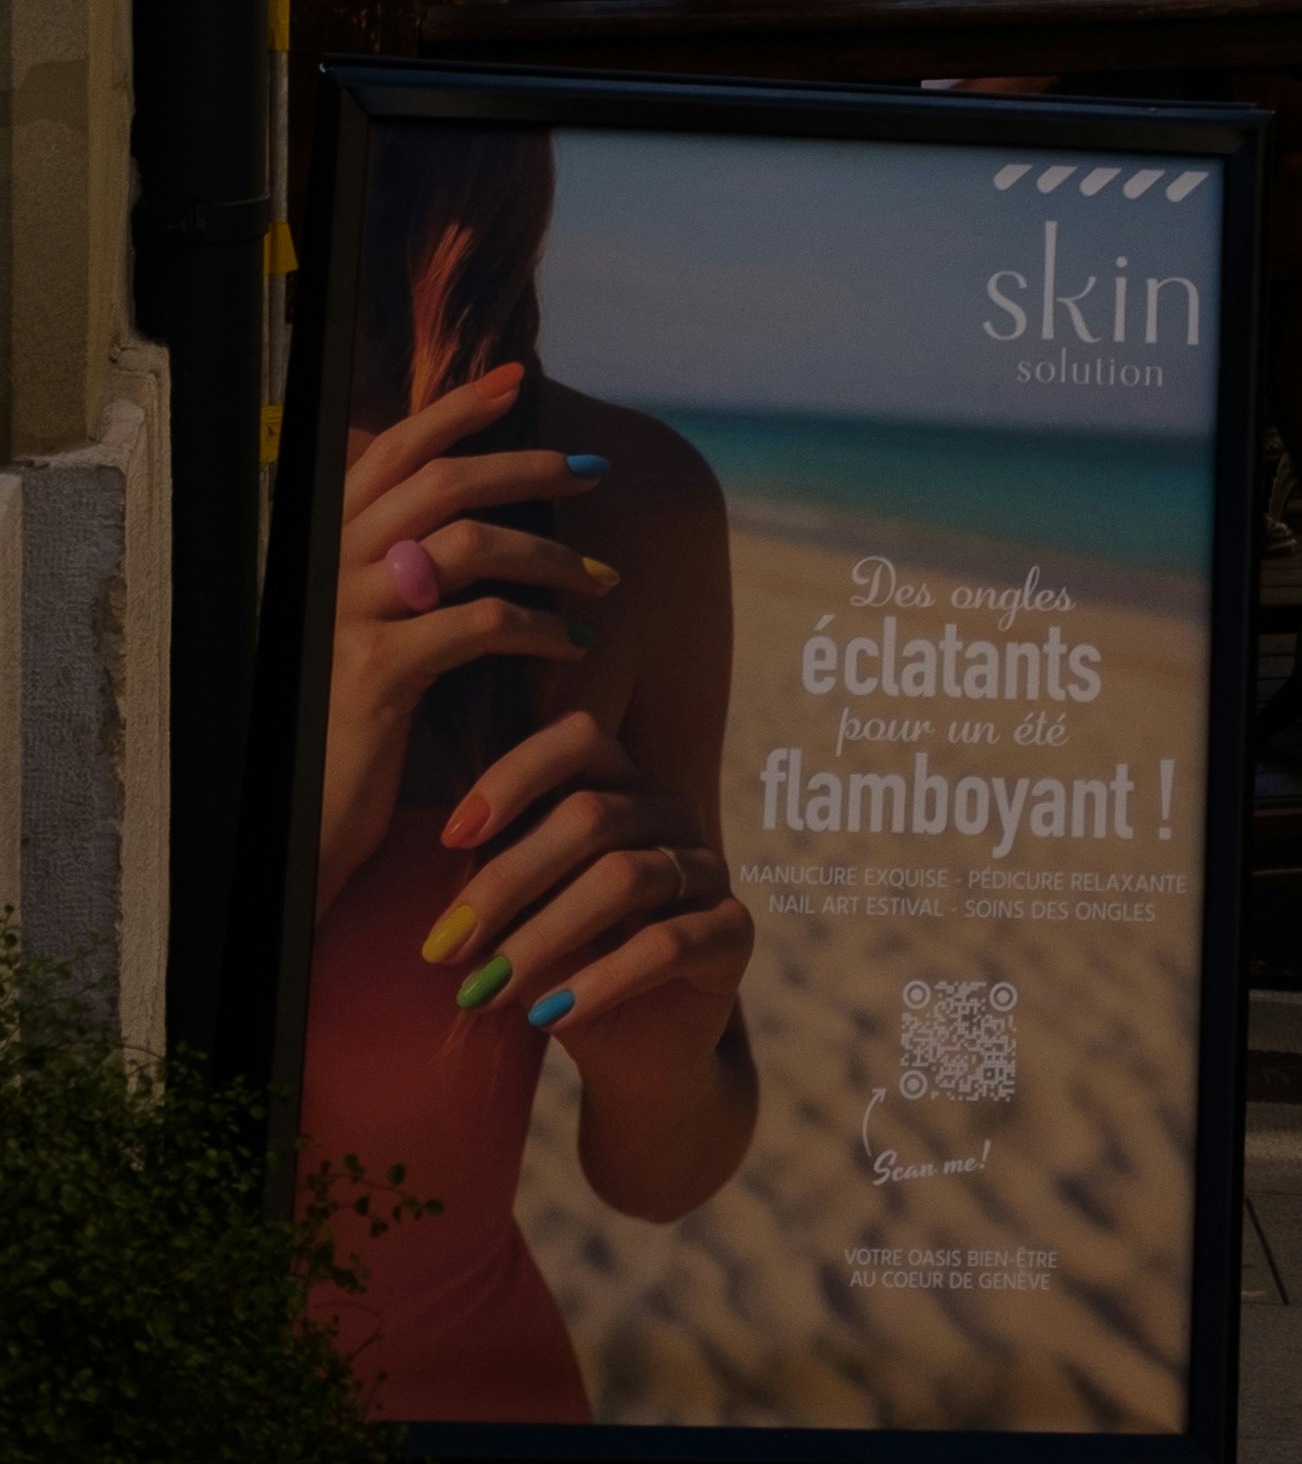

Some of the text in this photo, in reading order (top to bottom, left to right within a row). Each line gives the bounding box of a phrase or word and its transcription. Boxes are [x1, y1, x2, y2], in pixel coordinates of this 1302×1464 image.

[982, 220, 1201, 346] skin
[1016, 347, 1163, 388] solution
[849, 555, 1076, 632] Des ongles
[802, 613, 1102, 703] éclatants
[836, 708, 1068, 756] pour un été
[760, 746, 1134, 859] flamboyant
[739, 864, 857, 887] MANUCURE
[864, 868, 948, 890] EXQUISE
[968, 866, 1064, 891] PÉDICURE
[1071, 872, 1187, 894] RELAXANTE
[769, 894, 815, 914] NAIL
[822, 896, 860, 915] ART
[866, 897, 944, 917] ESTIVAL
[964, 899, 1024, 919] SOINS
[1031, 901, 1069, 920] DES
[1075, 902, 1156, 922] ONGLES
[872, 1139, 992, 1186] Scan me!
[844, 1247, 1058, 1269] VOTRE OASIS BIEN-ÊTRE
[850, 1269, 1051, 1290] AU COEUR DE GENÈVE
